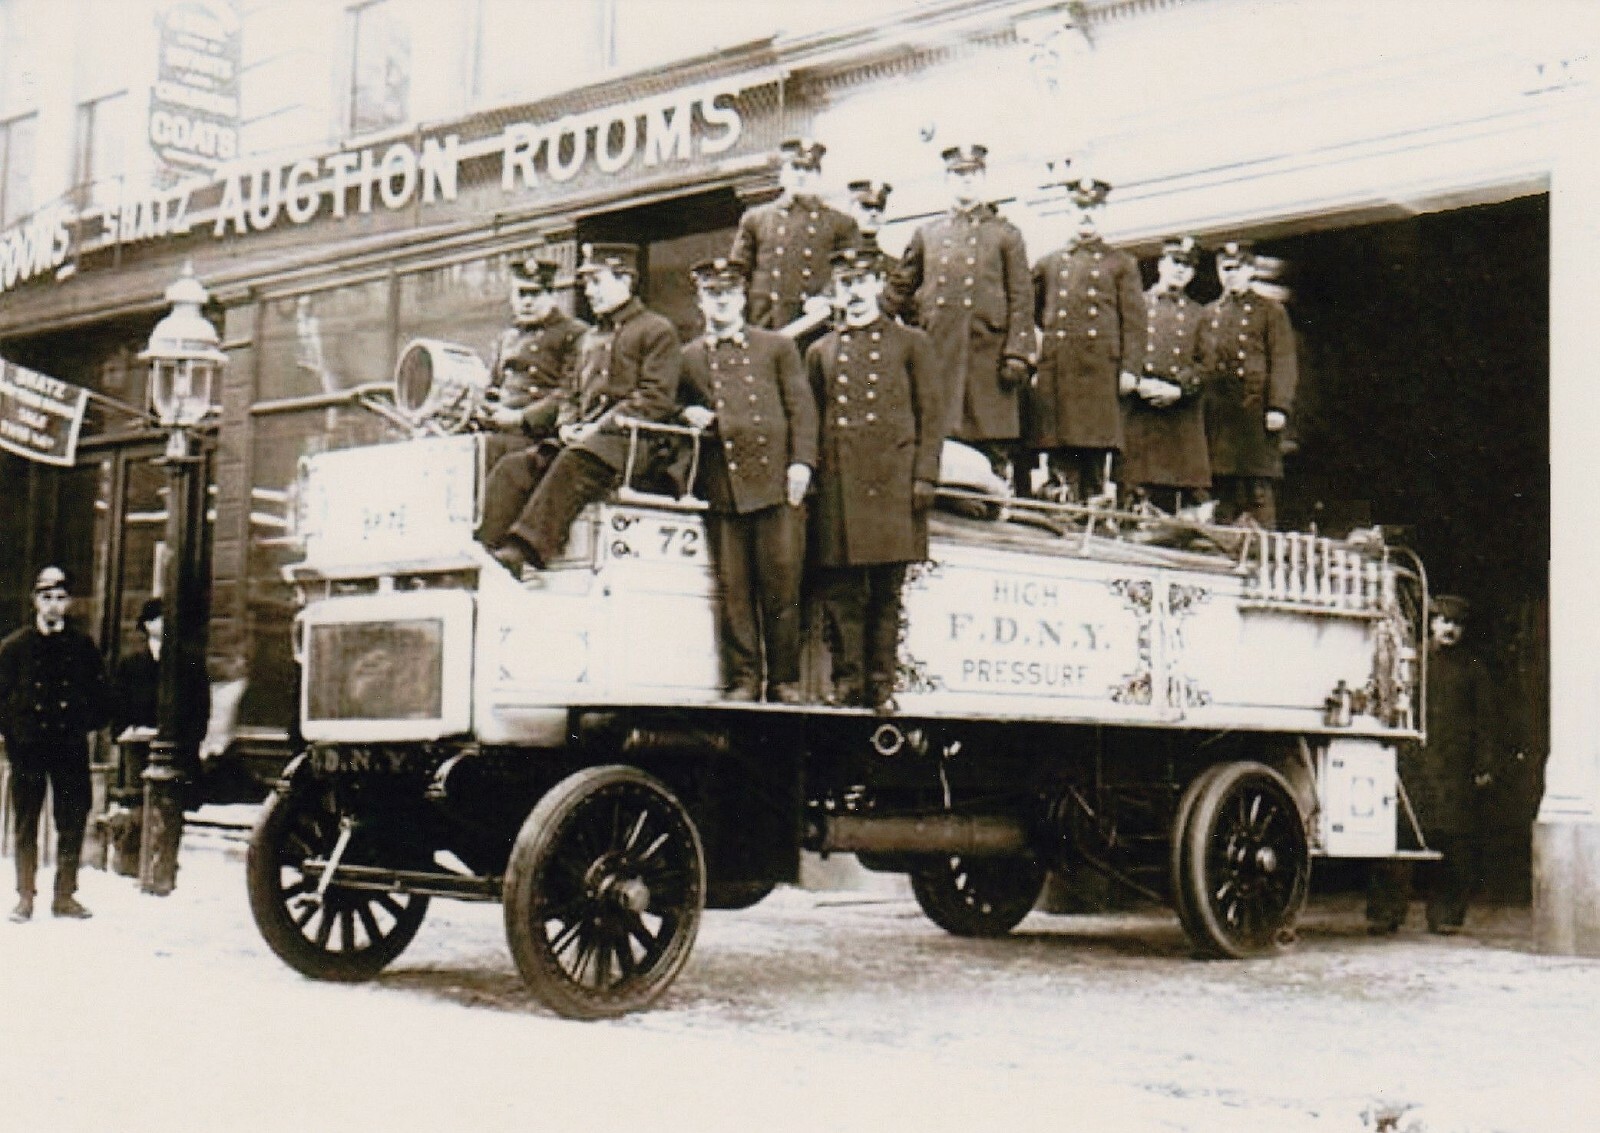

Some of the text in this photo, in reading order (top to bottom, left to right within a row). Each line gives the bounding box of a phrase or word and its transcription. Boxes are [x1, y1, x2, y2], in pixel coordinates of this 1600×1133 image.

[151, 110, 237, 159] COATS
[213, 134, 460, 236] AUCTION
[502, 90, 744, 191] ROOMS
[659, 526, 699, 558] 72
[994, 578, 1059, 607] HIGH
[949, 612, 1111, 650] F.D.N.Y.
